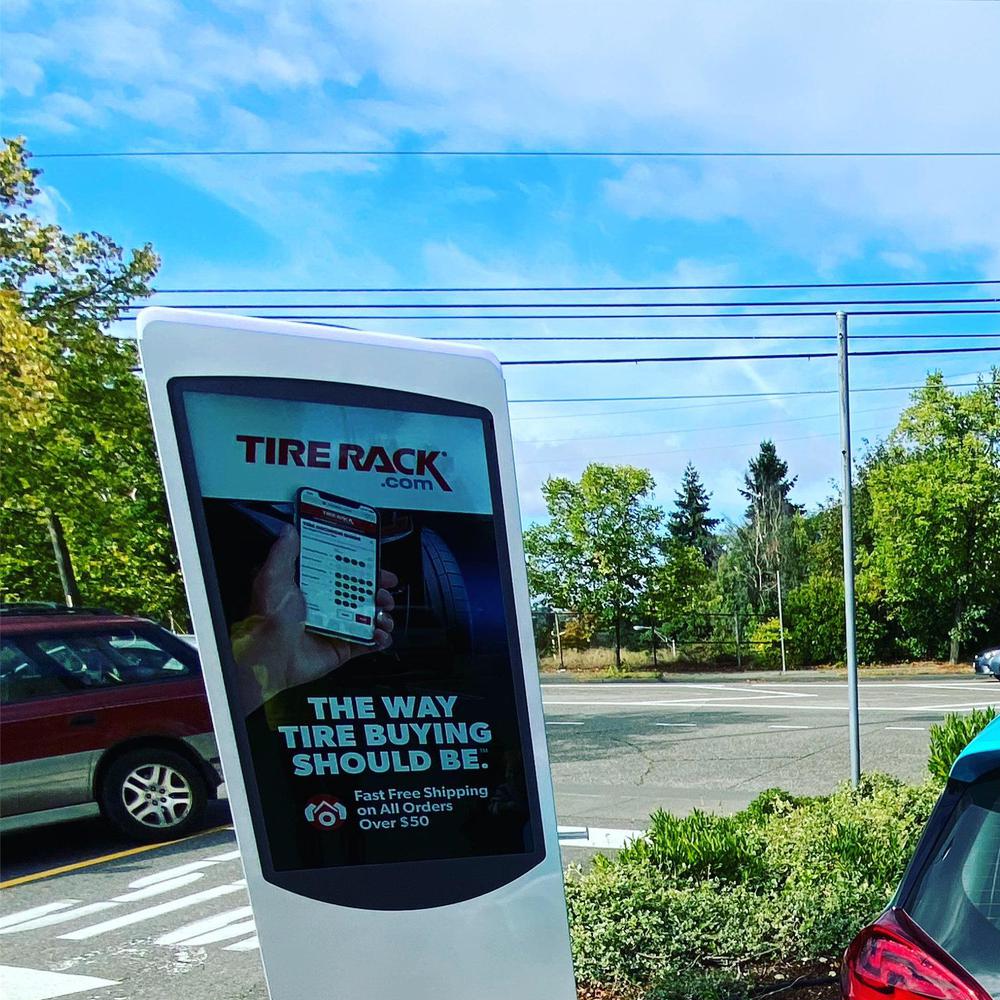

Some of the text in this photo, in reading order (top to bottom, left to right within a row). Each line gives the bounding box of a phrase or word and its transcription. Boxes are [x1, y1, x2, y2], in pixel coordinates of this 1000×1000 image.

[236, 435, 331, 469] TIRE
[381, 476, 433, 491] .com
[307, 695, 457, 720] THE WAY
[278, 721, 493, 749] TIRE BUYING
[292, 750, 432, 776] SHOULD
[354, 785, 488, 802] Fast Free Shipping
[357, 801, 453, 816] on All Orders
[359, 815, 430, 830] Over $50
